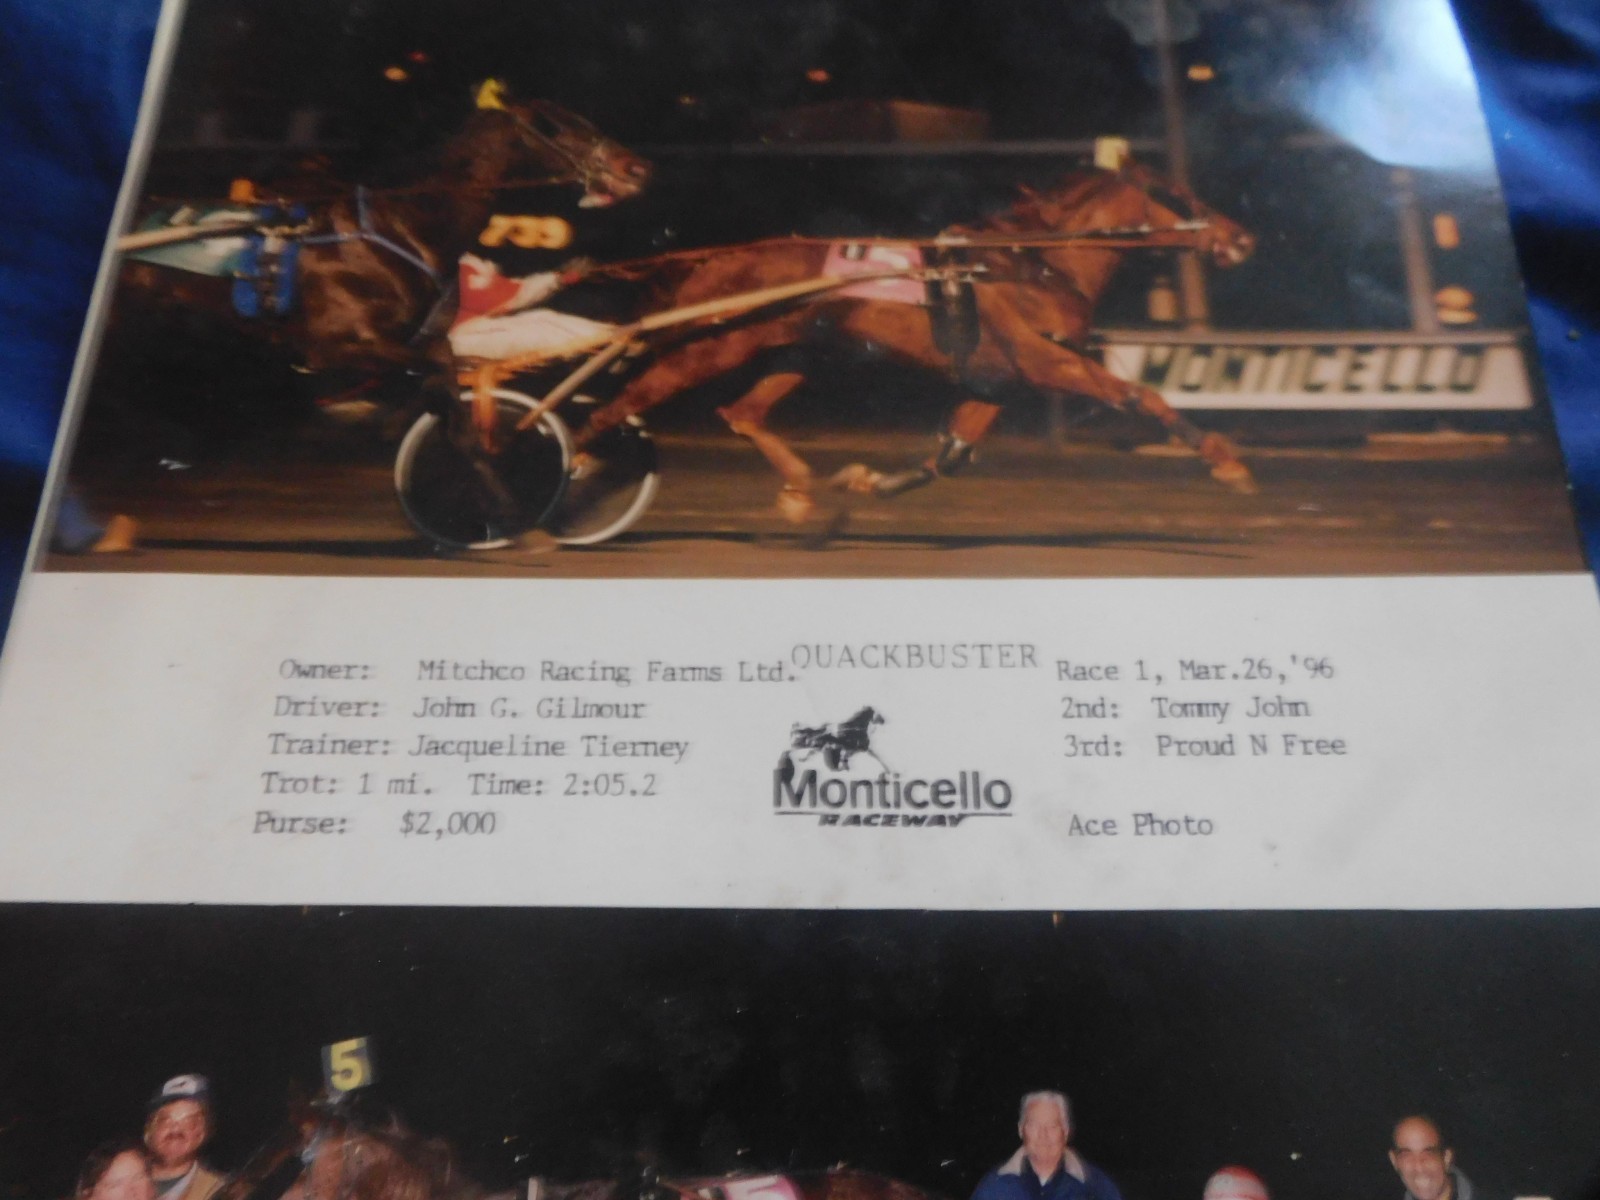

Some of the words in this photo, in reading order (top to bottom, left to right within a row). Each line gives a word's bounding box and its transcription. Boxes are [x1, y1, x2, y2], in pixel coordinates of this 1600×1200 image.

[791, 643, 1038, 670] QUACKBUSTER
[279, 658, 371, 680] Owner:
[417, 660, 526, 682] Mitchco
[539, 660, 631, 686] Racing
[646, 661, 723, 682] Farms
[738, 661, 796, 683] Ltd.
[1056, 659, 1120, 682] Race
[1135, 660, 1164, 685] 1,
[274, 694, 382, 718] Driver:
[413, 697, 475, 719] John
[490, 697, 519, 719] G.
[536, 696, 647, 719] Gilmour
[1061, 696, 1120, 719] 2nd:
[1150, 696, 1230, 724] Tommy
[1246, 695, 1311, 718] John
[268, 732, 391, 757] Trainer:
[407, 734, 566, 762] Jacqueline
[580, 735, 689, 764] Tierney
[1064, 734, 1123, 757] 3rd:
[1155, 733, 1237, 757] Proud
[1248, 734, 1268, 756] N
[1282, 733, 1347, 756] Free
[260, 771, 338, 796] Trot:
[357, 772, 371, 796] 1
[386, 773, 434, 796] mi.
[467, 772, 545, 797] Time:
[563, 773, 658, 797] 2:05.2
[772, 769, 1013, 810] Monticello
[252, 810, 348, 835] Purse:
[398, 810, 497, 841] $2,000
[817, 813, 966, 828] RACEWAY
[1067, 813, 1119, 837] Ace
[1132, 812, 1215, 837] Photo
[331, 1037, 370, 1092] 5
